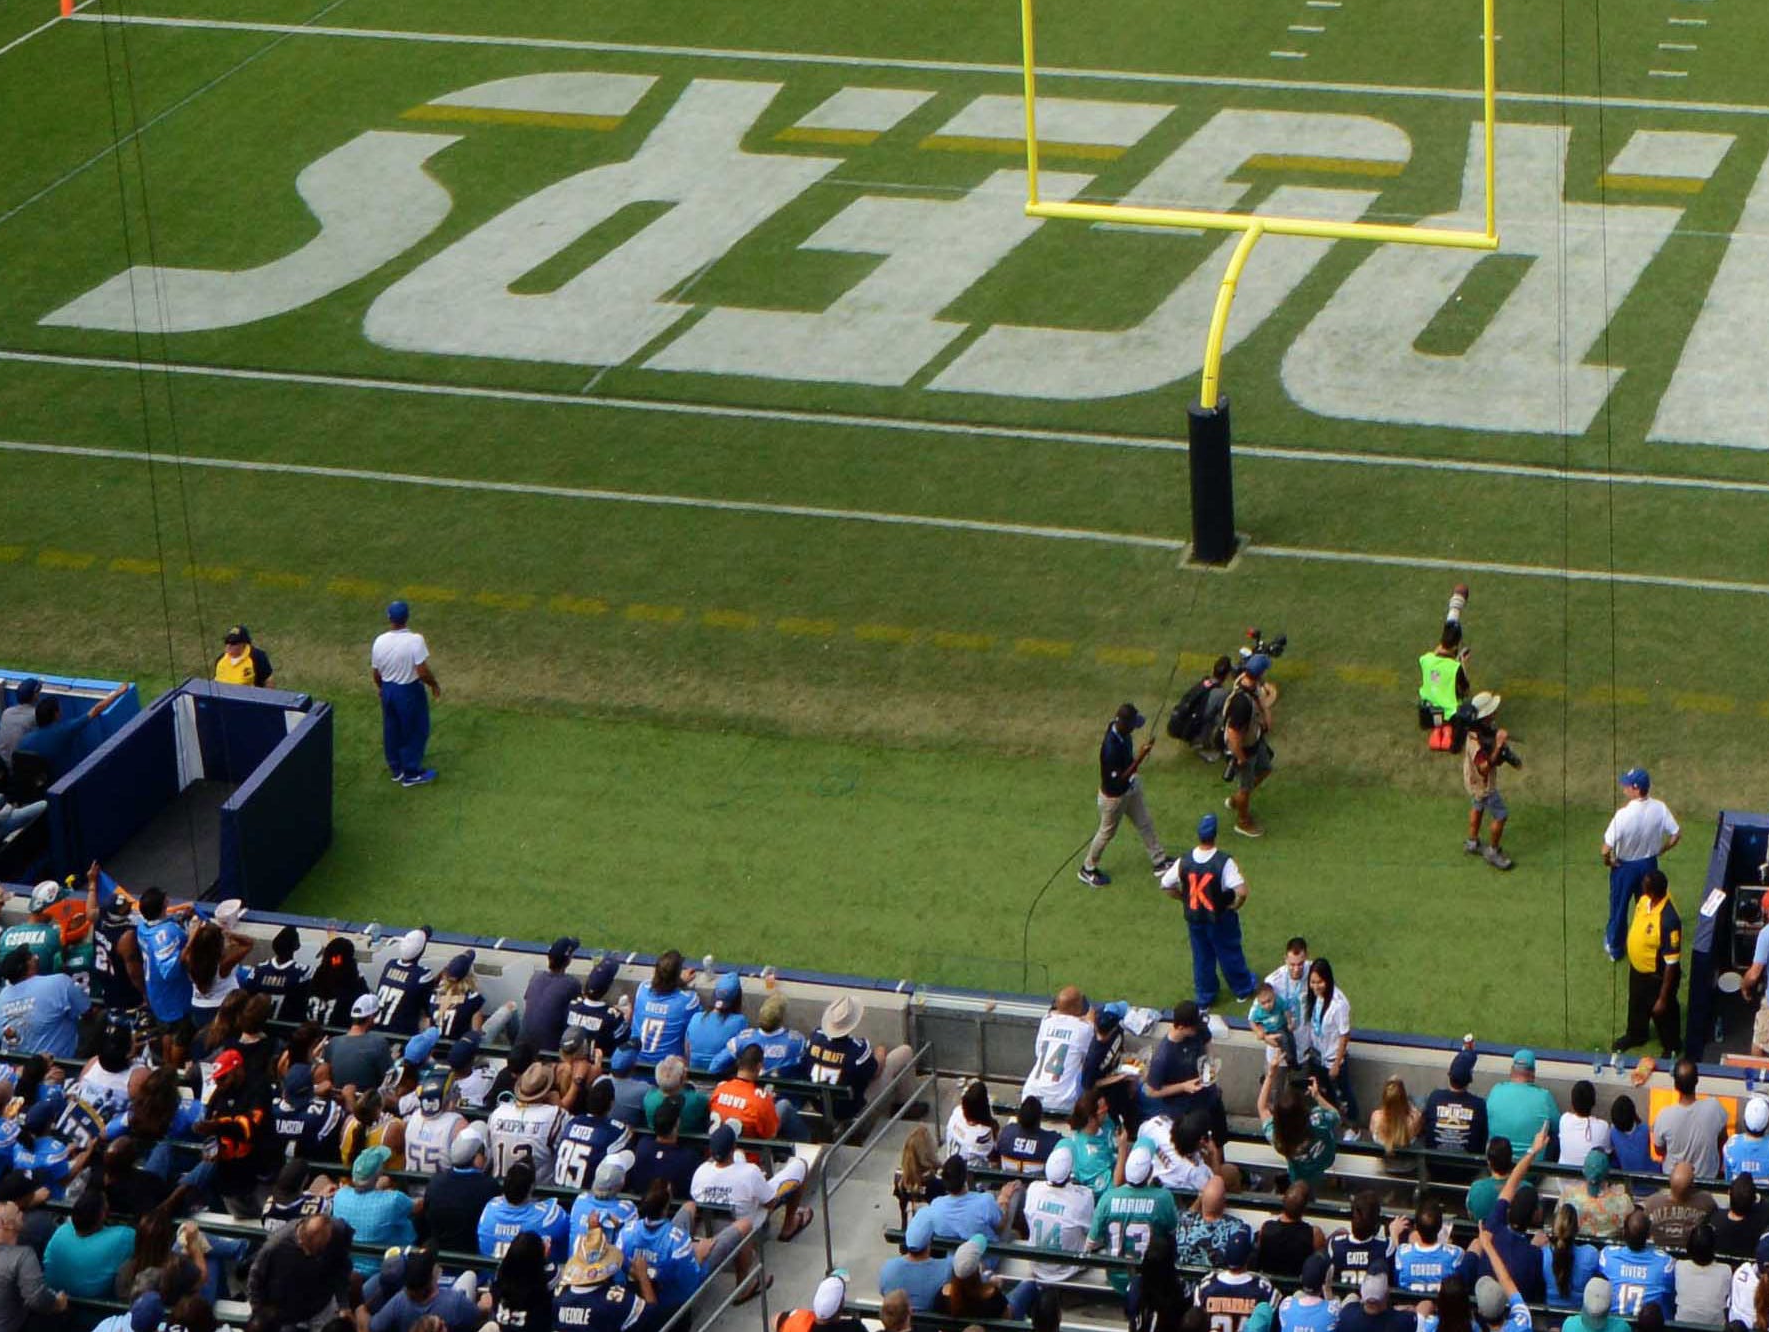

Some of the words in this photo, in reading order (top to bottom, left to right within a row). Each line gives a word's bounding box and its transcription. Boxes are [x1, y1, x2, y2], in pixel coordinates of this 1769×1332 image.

[1187, 871, 1215, 913] K
[6, 930, 46, 945] CSONKA
[640, 1018, 665, 1053] 17
[1034, 1040, 1067, 1081] 14
[1014, 1137, 1036, 1154] SEAU
[556, 1143, 590, 1188] 85
[1111, 1198, 1155, 1216] MARINO
[1032, 1218, 1063, 1249] 14
[1107, 1222, 1151, 1259] 13
[1619, 1264, 1647, 1280] RIVERS
[1617, 1283, 1645, 1314] 17
[558, 1307, 591, 1326] WEDDLE
